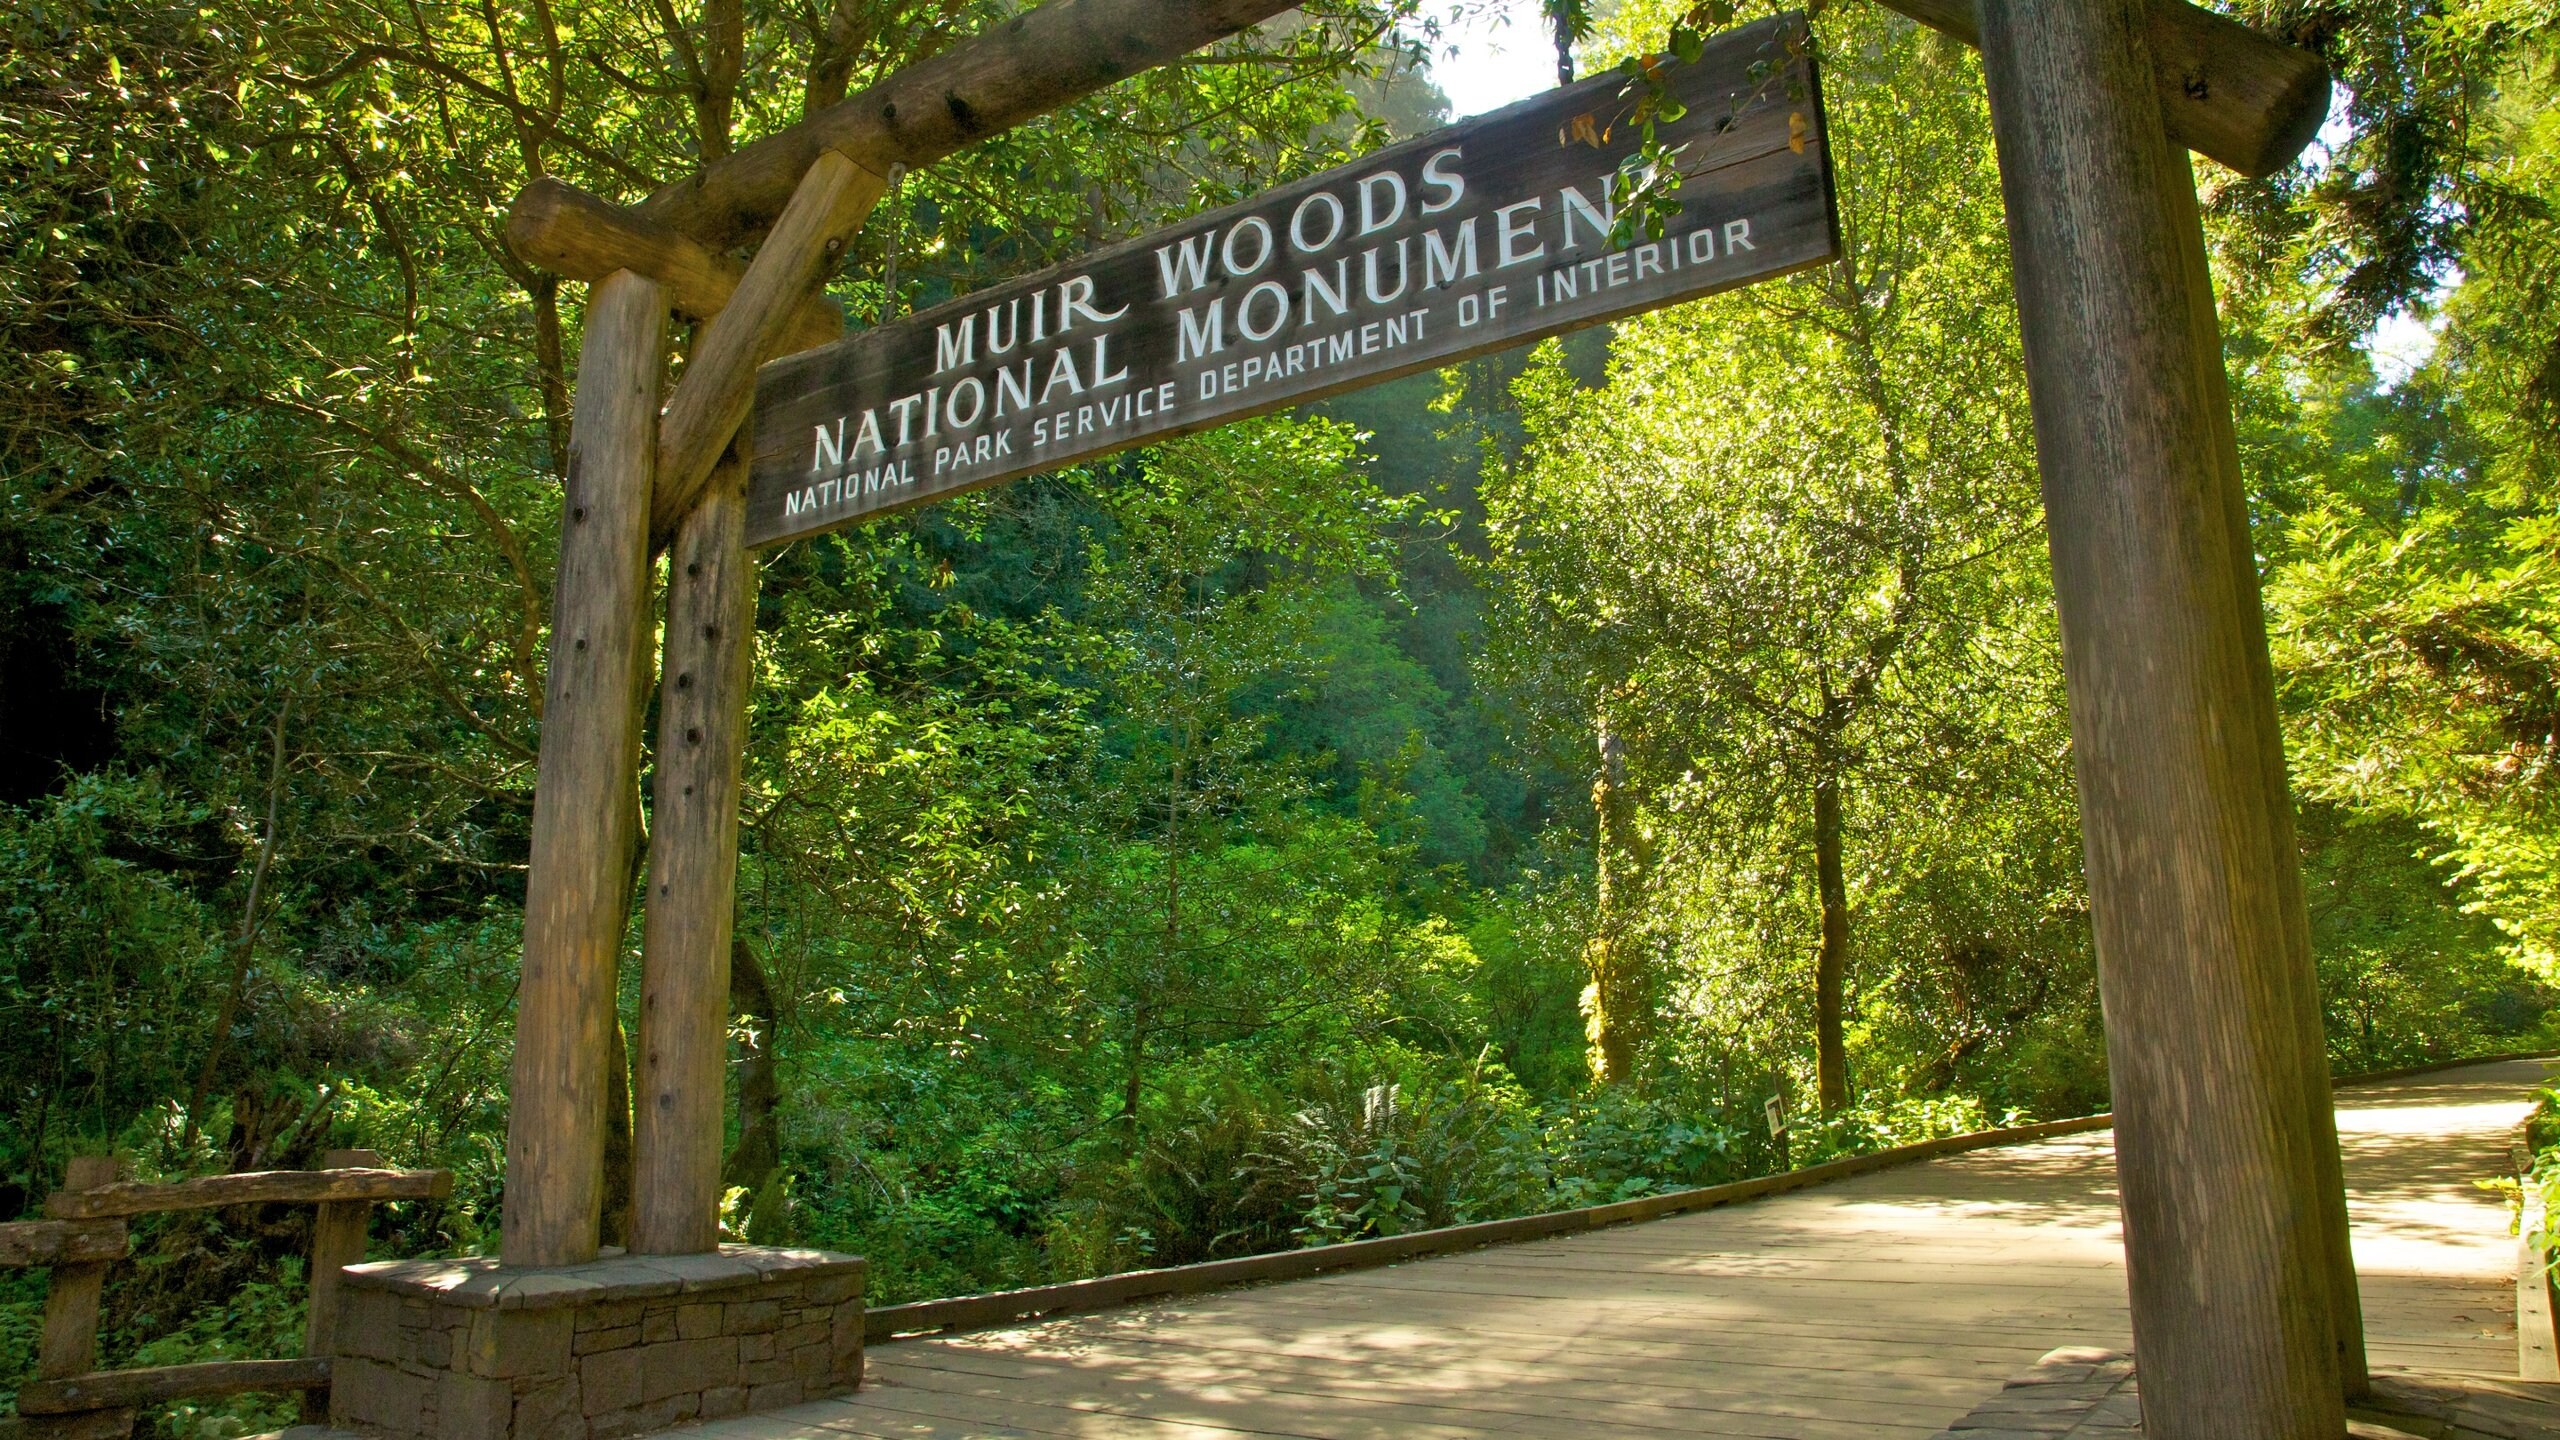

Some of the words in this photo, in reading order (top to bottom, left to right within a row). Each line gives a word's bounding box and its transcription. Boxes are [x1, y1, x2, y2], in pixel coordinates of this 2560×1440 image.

[785, 460, 914, 516] NATIONAL
[934, 428, 1012, 474] PARK
[1033, 381, 1175, 447] SERVICE
[1200, 308, 1429, 400] DEPARTMENT
[1458, 285, 1507, 328] OF
[1538, 218, 1755, 306] INTERIOR
[812, 334, 1128, 472] NATIONAL
[1177, 157, 1676, 363] MONUMEN
[934, 275, 1129, 375] MUIR
[1155, 146, 1466, 299] WOODS
